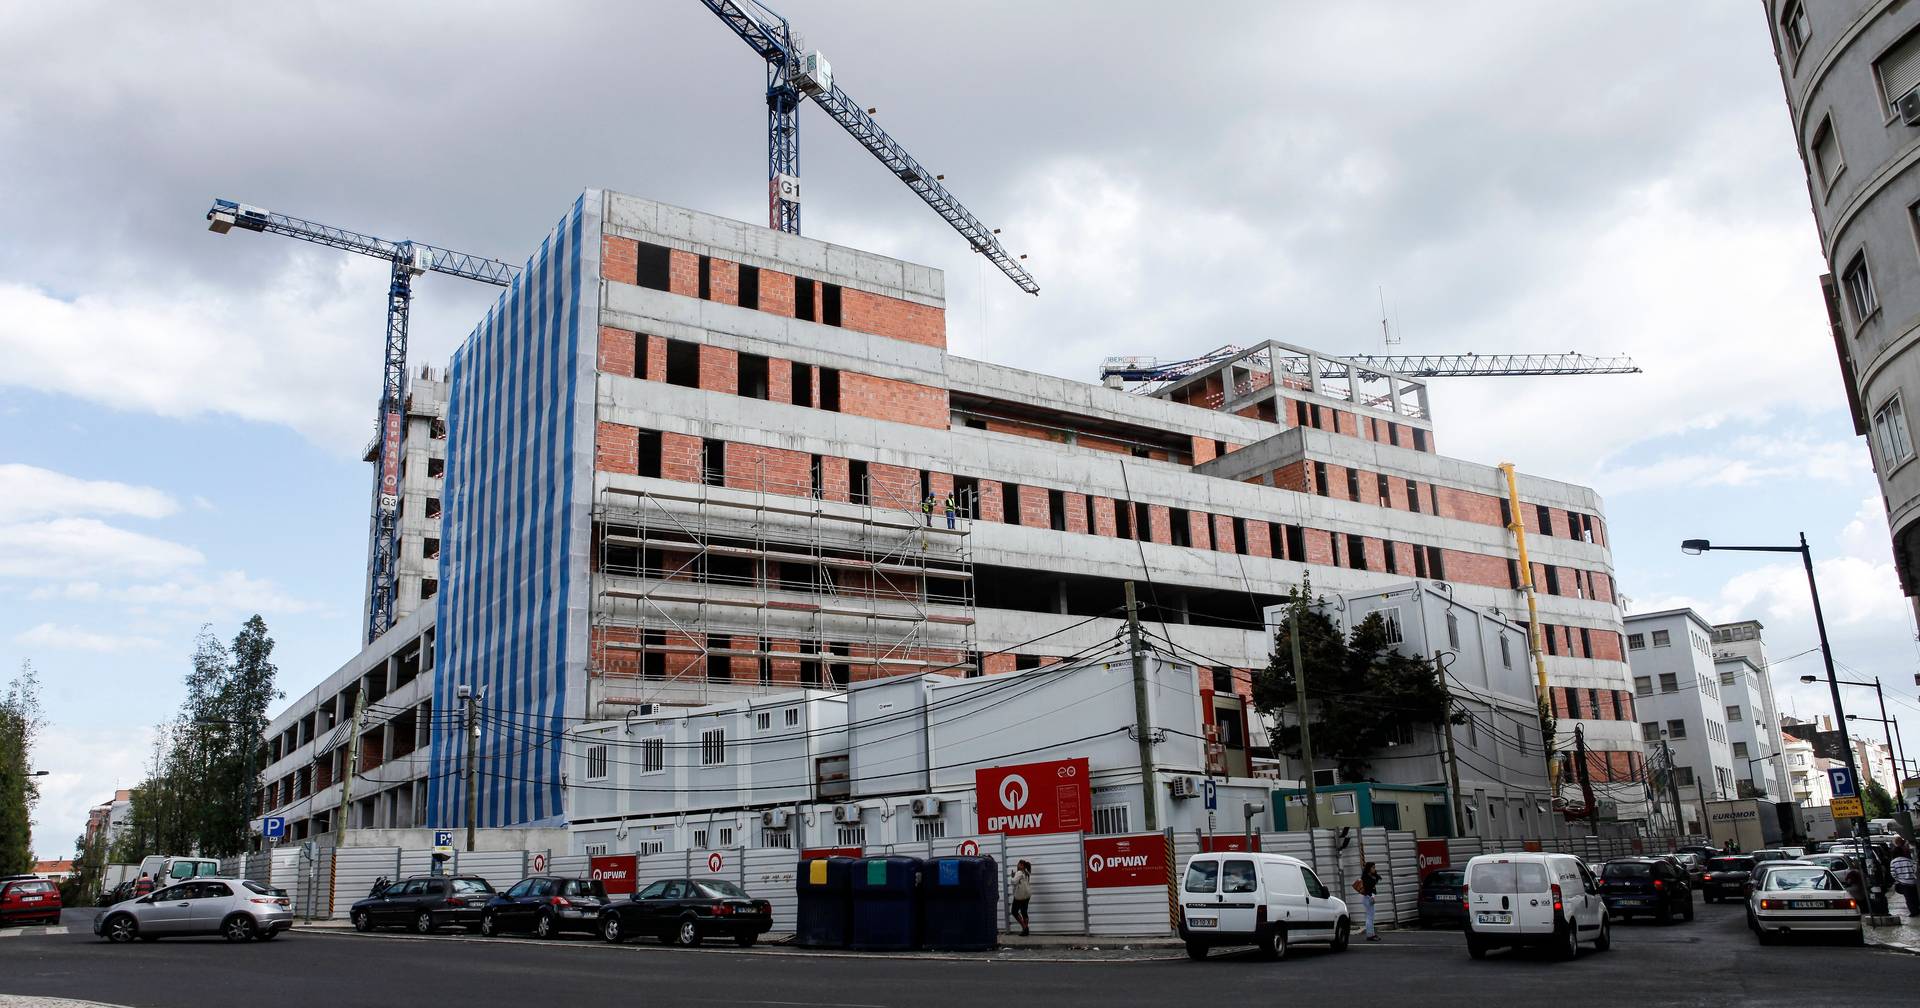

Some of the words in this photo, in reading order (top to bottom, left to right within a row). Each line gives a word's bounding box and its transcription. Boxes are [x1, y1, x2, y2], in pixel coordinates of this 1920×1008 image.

[781, 181, 800, 197] G1
[389, 420, 398, 468] OPWAY
[381, 497, 396, 506] G3
[1833, 772, 1846, 793] P
[1206, 783, 1214, 807] P
[987, 813, 1043, 831] OPWAY
[1713, 811, 1755, 819] EUROMOR
[267, 819, 280, 835] P
[440, 834, 447, 844] P
[1107, 855, 1148, 867] OPWAY
[1426, 857, 1442, 865] OPWAY
[603, 870, 627, 879] OPWAY
